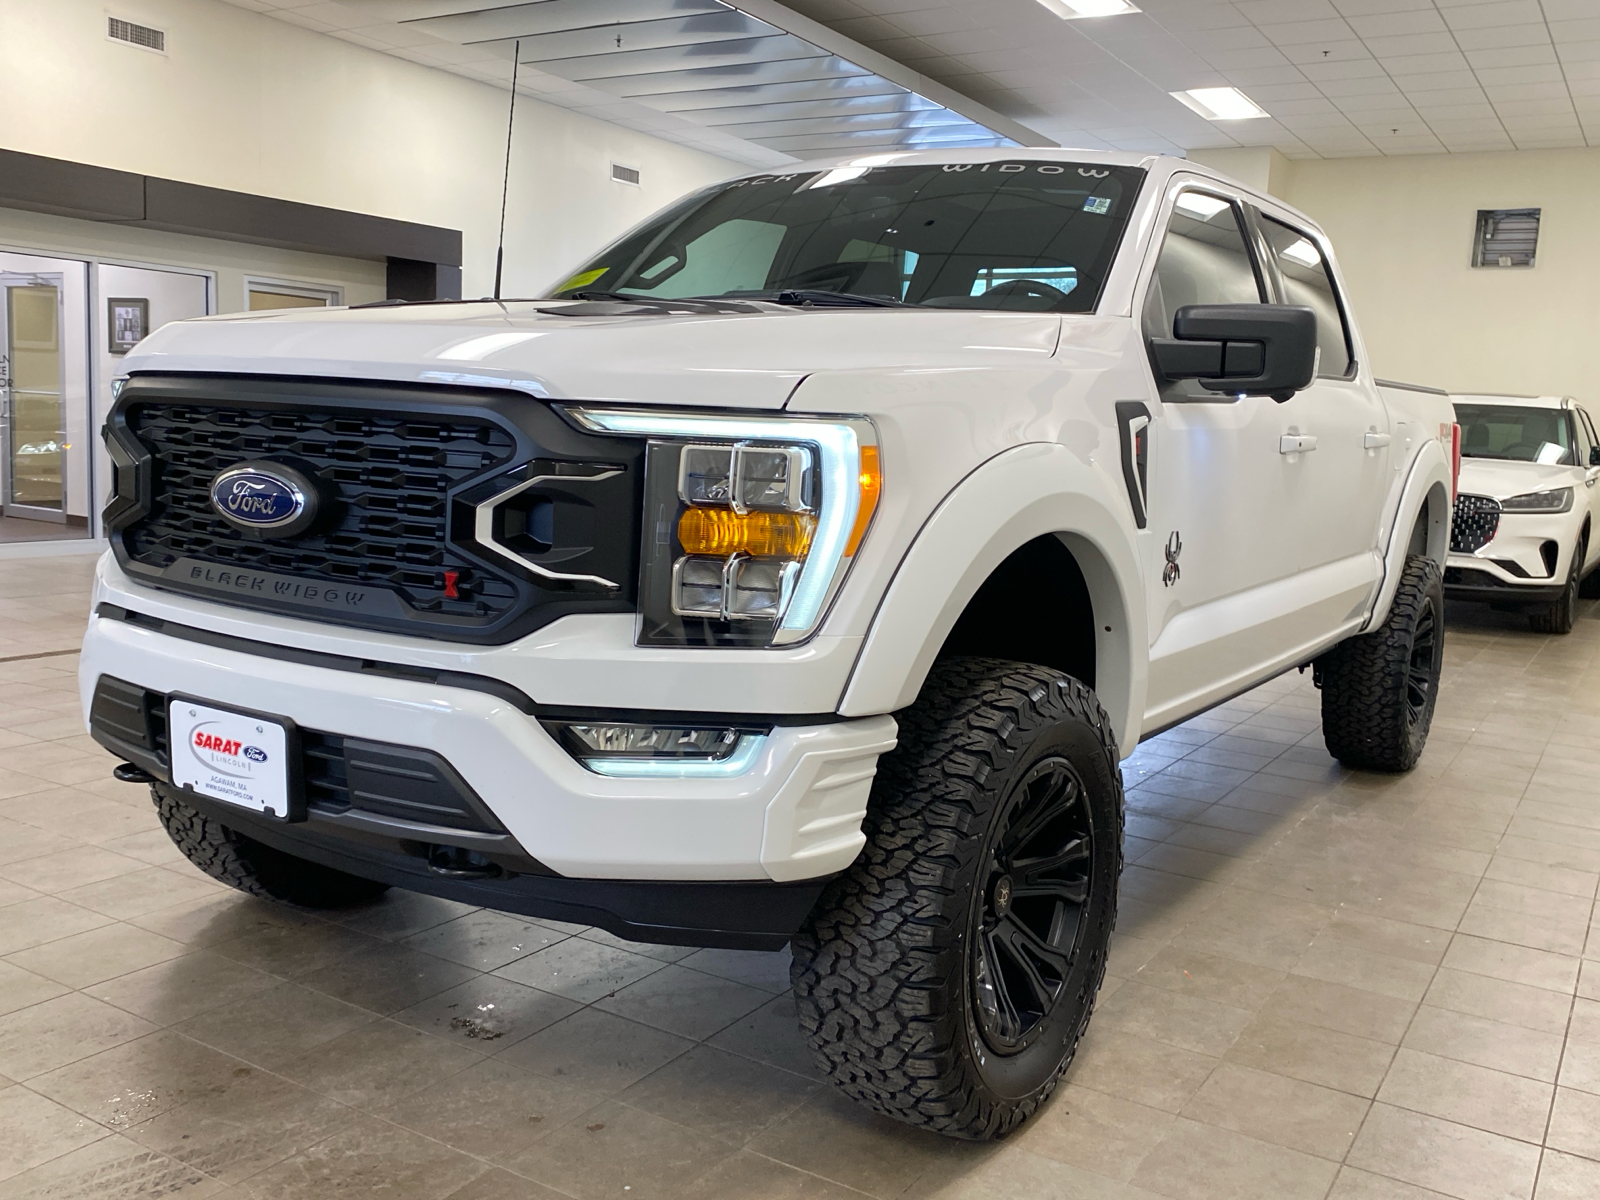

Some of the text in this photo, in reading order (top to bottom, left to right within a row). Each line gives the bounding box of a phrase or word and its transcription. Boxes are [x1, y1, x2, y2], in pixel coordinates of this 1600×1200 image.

[725, 164, 1110, 190] ACK WIDOW
[228, 480, 277, 515] Ford
[190, 566, 366, 606] BLACK WIDOW
[194, 731, 265, 761] SARAT Ford
[216, 755, 246, 768] LINCOLN
[205, 783, 253, 800] WWW.SARATFORD.COM
[211, 775, 247, 791] AGAWAM, MA
